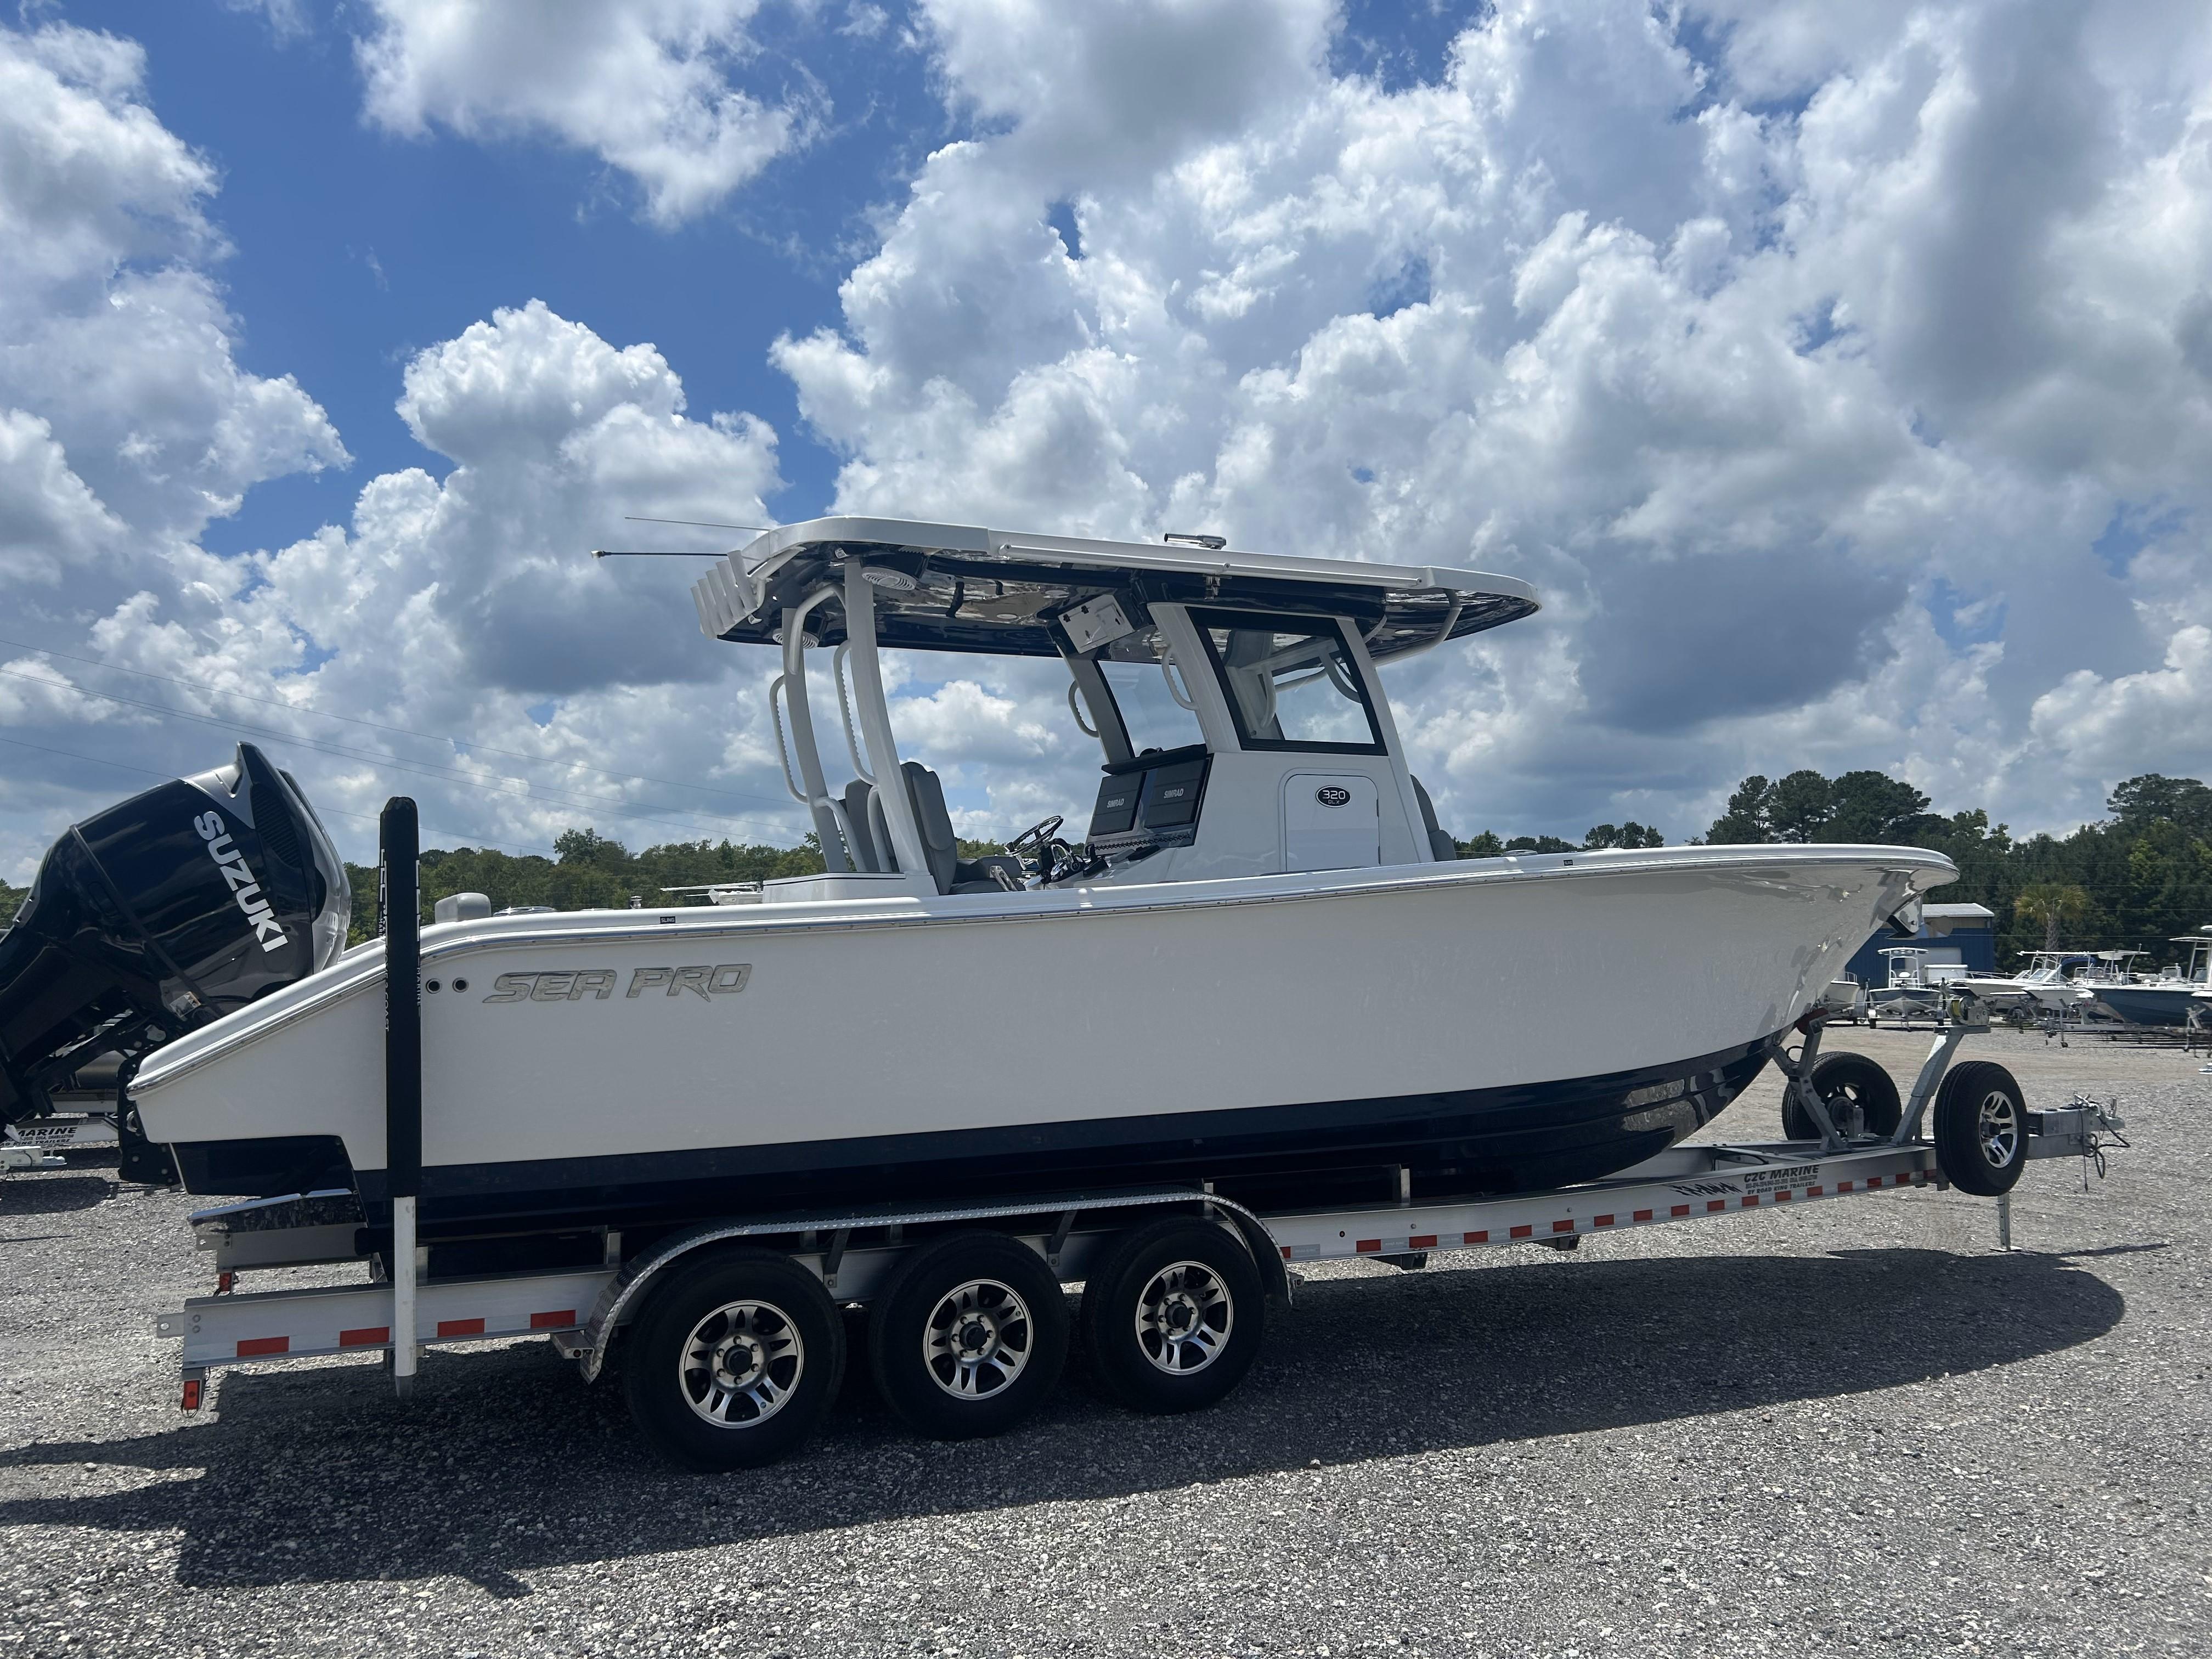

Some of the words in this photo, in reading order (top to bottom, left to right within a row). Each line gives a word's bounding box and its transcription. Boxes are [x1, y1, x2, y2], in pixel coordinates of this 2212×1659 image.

[1322, 790, 1346, 799] 320
[194, 811, 289, 952] SUZUKI
[482, 969, 618, 1003] SEA
[626, 964, 753, 1002] PRO
[1744, 1171, 1766, 1183] C2C
[1770, 1165, 1820, 1180] MARINE
[1790, 1181, 1816, 1189] TRAILERS
